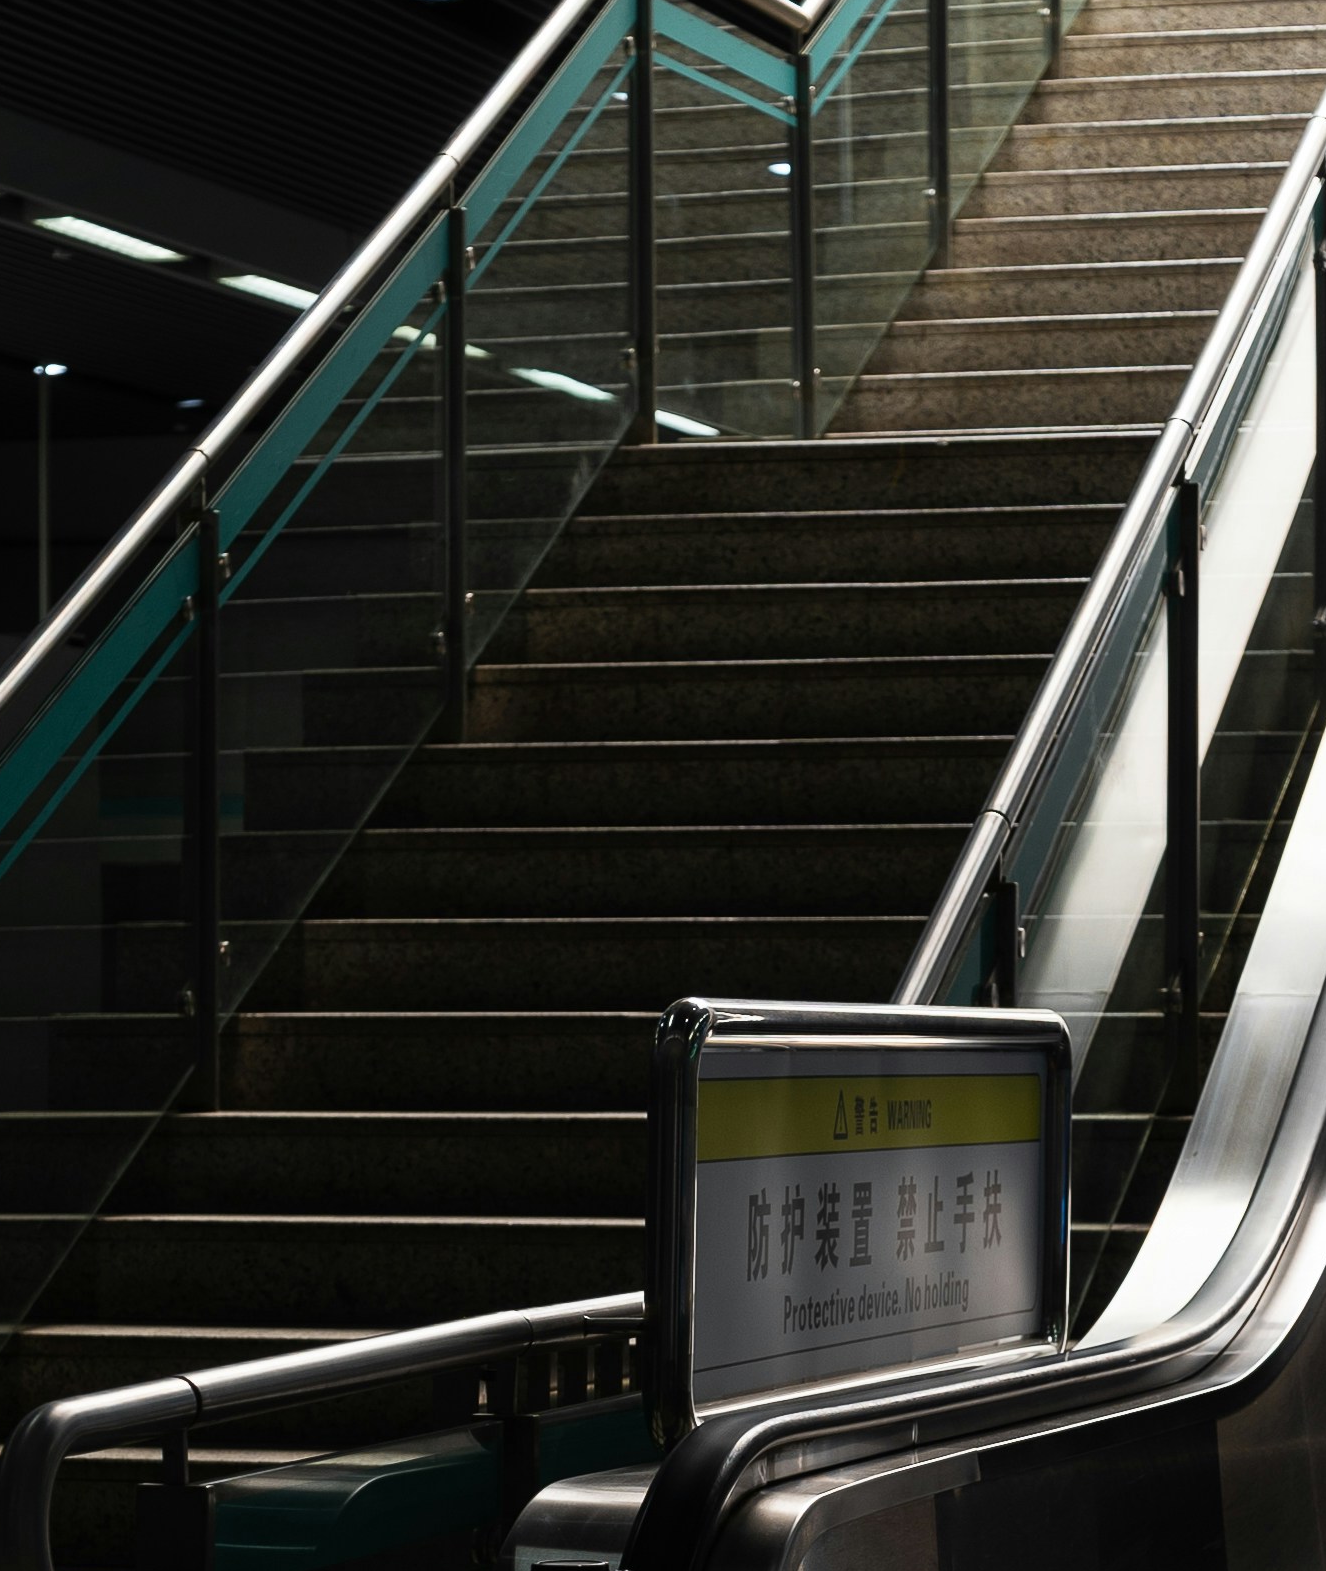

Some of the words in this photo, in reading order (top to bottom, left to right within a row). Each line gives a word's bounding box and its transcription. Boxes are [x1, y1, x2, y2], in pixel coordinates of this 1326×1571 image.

[854, 1094, 879, 1136] 警告
[887, 1099, 933, 1131] WARNING
[746, 1181, 873, 1282] 防护装置
[896, 1169, 1002, 1261] 禁止手扶
[783, 1289, 855, 1334] Protective
[857, 1282, 902, 1323] device.
[905, 1277, 922, 1314] No
[923, 1270, 970, 1313] holding
